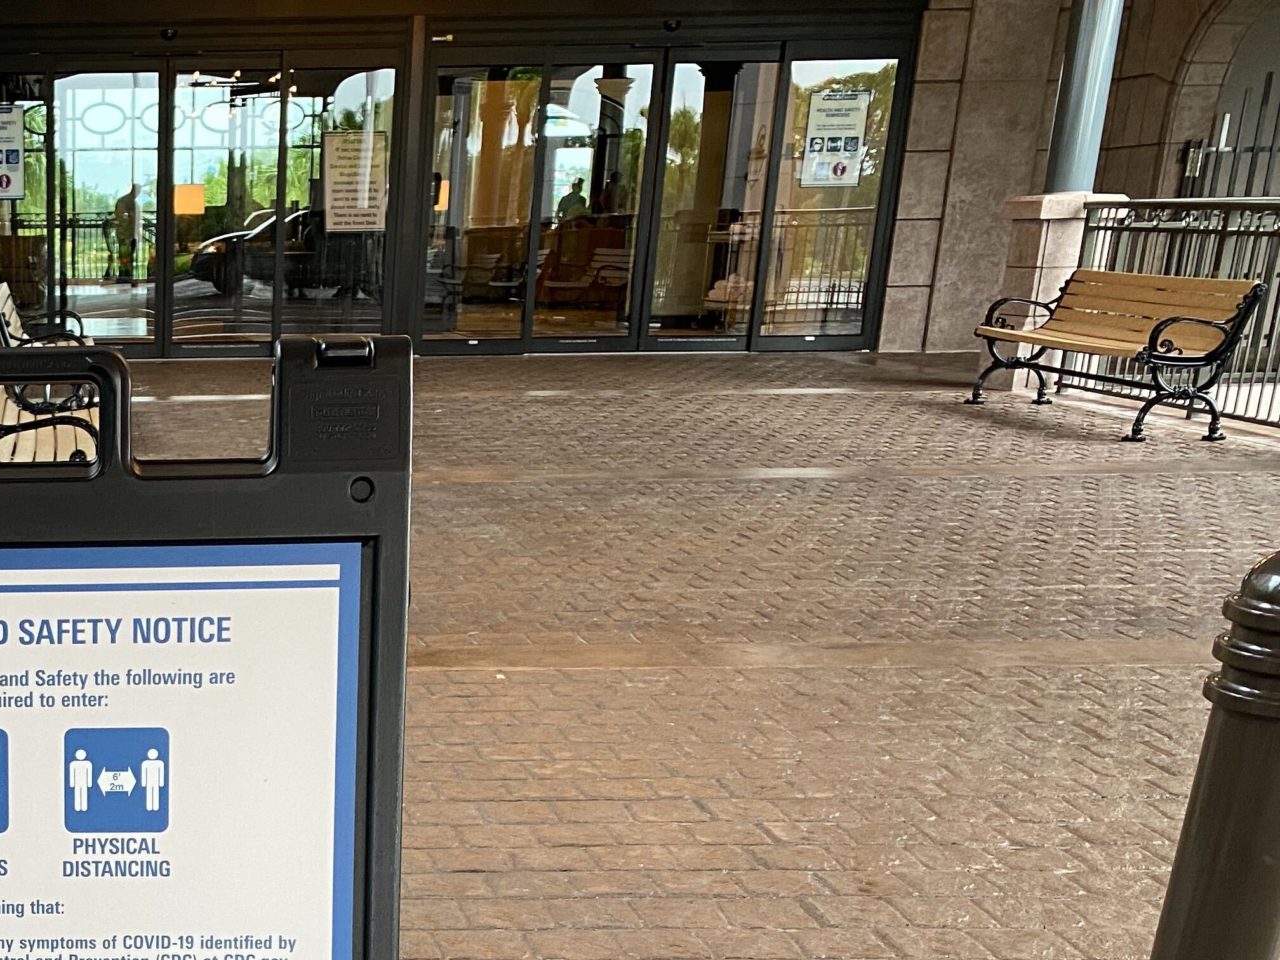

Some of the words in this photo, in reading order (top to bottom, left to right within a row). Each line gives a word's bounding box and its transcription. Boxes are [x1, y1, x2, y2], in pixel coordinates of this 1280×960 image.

[18, 618, 123, 646] SAFETY
[133, 616, 231, 644] NOTICE
[0, 670, 29, 687] and
[35, 669, 88, 690] Safety
[93, 669, 120, 686] the
[125, 668, 203, 689] following
[209, 672, 235, 684] are
[39, 693, 55, 708] to
[61, 693, 108, 708] enter:
[109, 782, 125, 791] 2m
[73, 837, 160, 855] PHYSICAL
[63, 860, 170, 877] DISTANCING
[30, 899, 64, 915] that:
[19, 937, 97, 953] symptoms
[102, 935, 117, 950] of
[123, 935, 194, 950] COVID-19
[200, 935, 272, 950] identified
[279, 935, 296, 953] by
